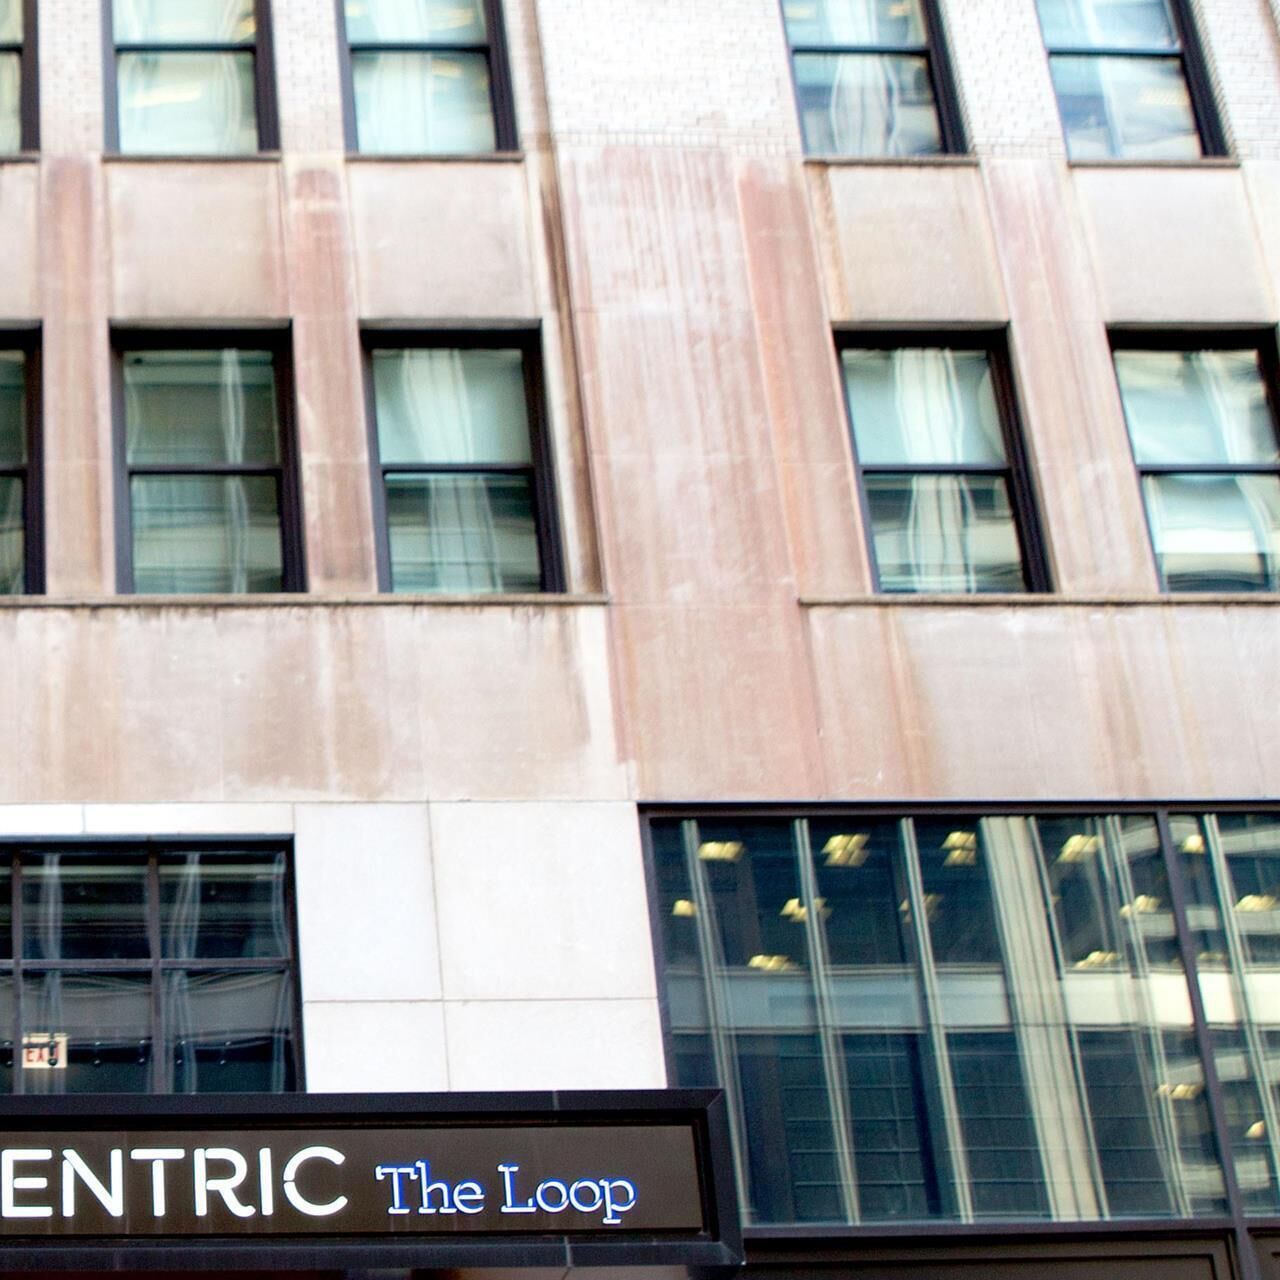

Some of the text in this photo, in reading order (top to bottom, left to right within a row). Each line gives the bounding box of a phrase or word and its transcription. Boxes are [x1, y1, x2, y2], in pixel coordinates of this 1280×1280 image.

[26, 1042, 61, 1062] EXT
[375, 1160, 485, 1215] The
[497, 1163, 637, 1224] Loop
